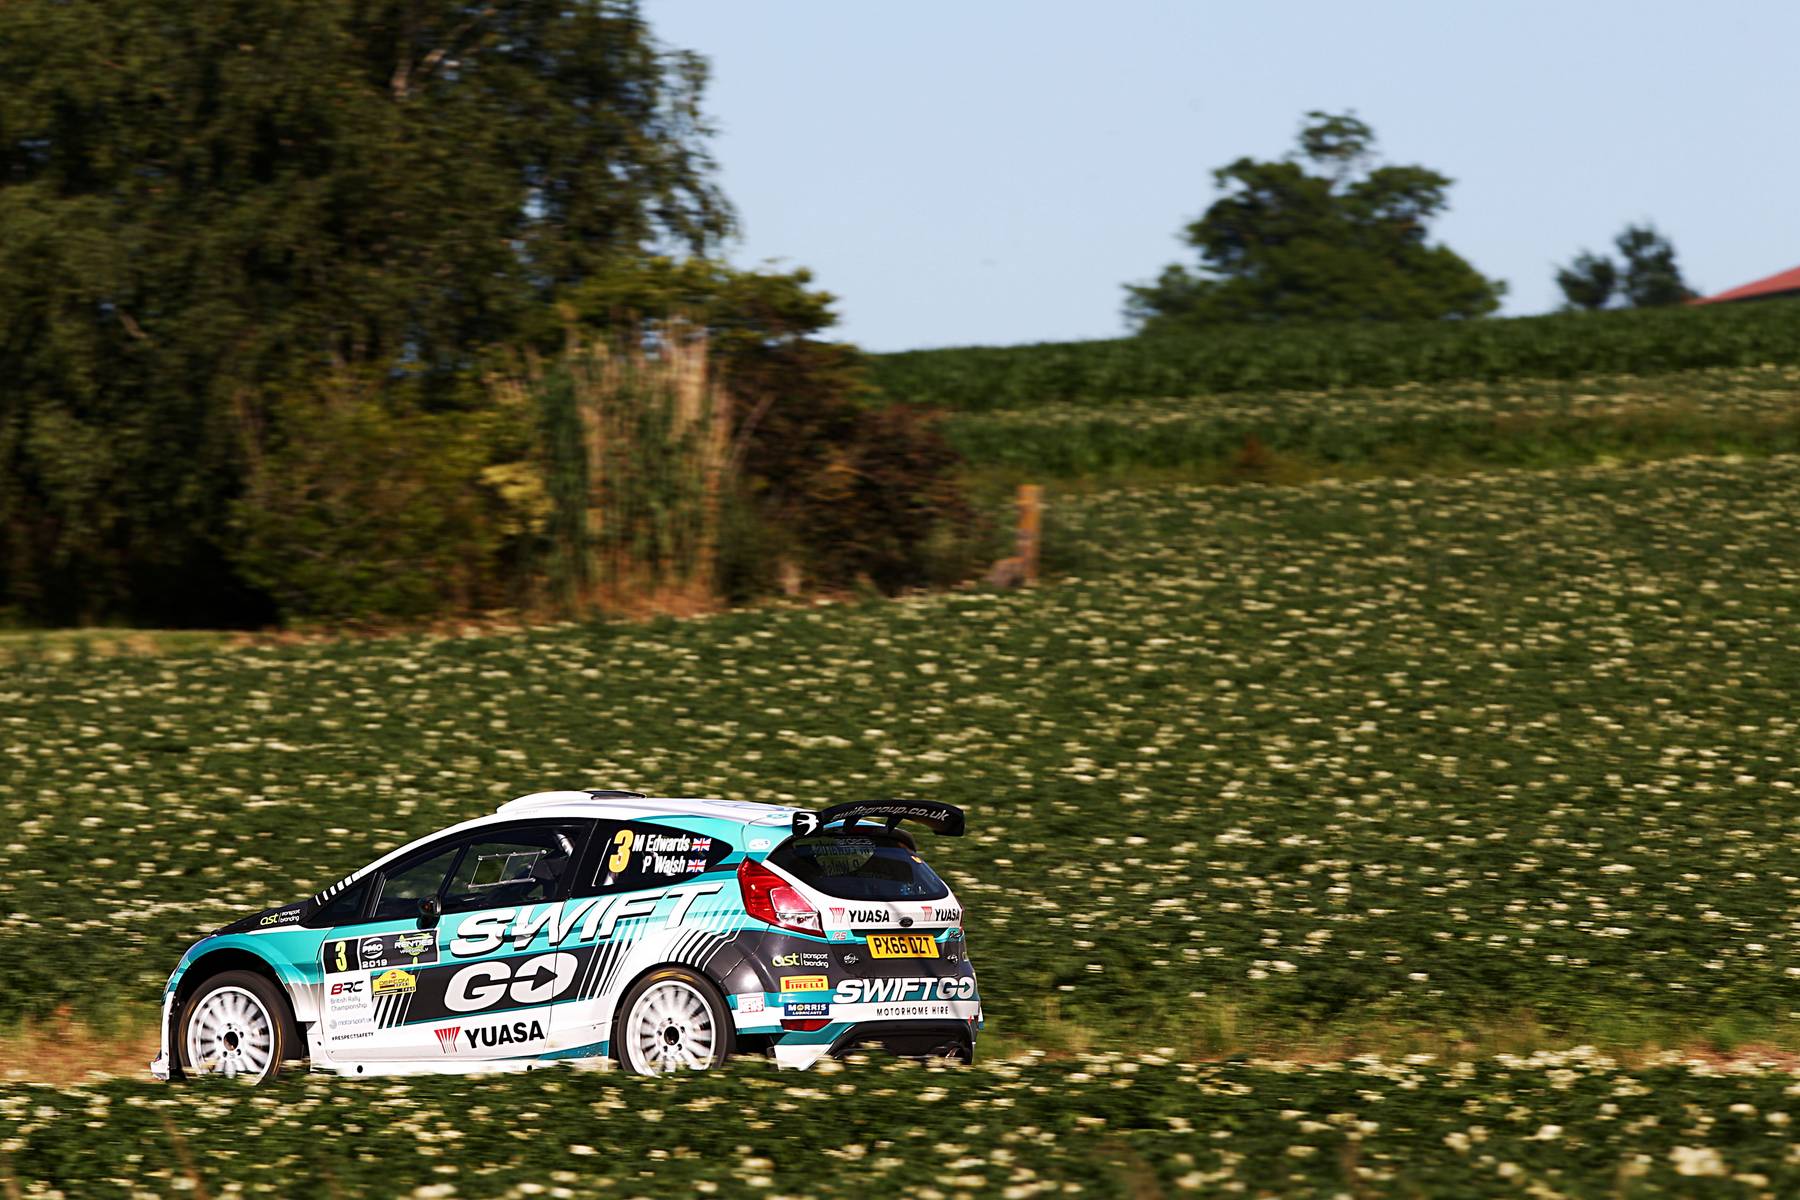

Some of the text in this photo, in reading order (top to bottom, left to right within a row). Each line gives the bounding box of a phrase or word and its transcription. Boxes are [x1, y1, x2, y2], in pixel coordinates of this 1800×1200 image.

[832, 805, 950, 822] swiftgroup.co.uk
[608, 829, 634, 873] 3
[632, 834, 690, 852] M Edwards
[642, 855, 686, 874] P Walsh
[260, 912, 279, 925] ast
[449, 881, 726, 958] SWIFT
[848, 909, 890, 923] YUASA
[935, 908, 960, 922] YUASA
[873, 937, 908, 955] PX66
[335, 940, 348, 971] 3
[362, 958, 388, 969] 2019
[772, 952, 829, 967] ast transport
[803, 960, 829, 968] branding
[331, 980, 365, 996] BRC
[444, 951, 578, 1012] GO
[785, 979, 824, 990] PIRELLI
[788, 1003, 827, 1012] MORRIS
[876, 1006, 949, 1017] MOTORHOME HIRE
[464, 1020, 546, 1048] YUASA
